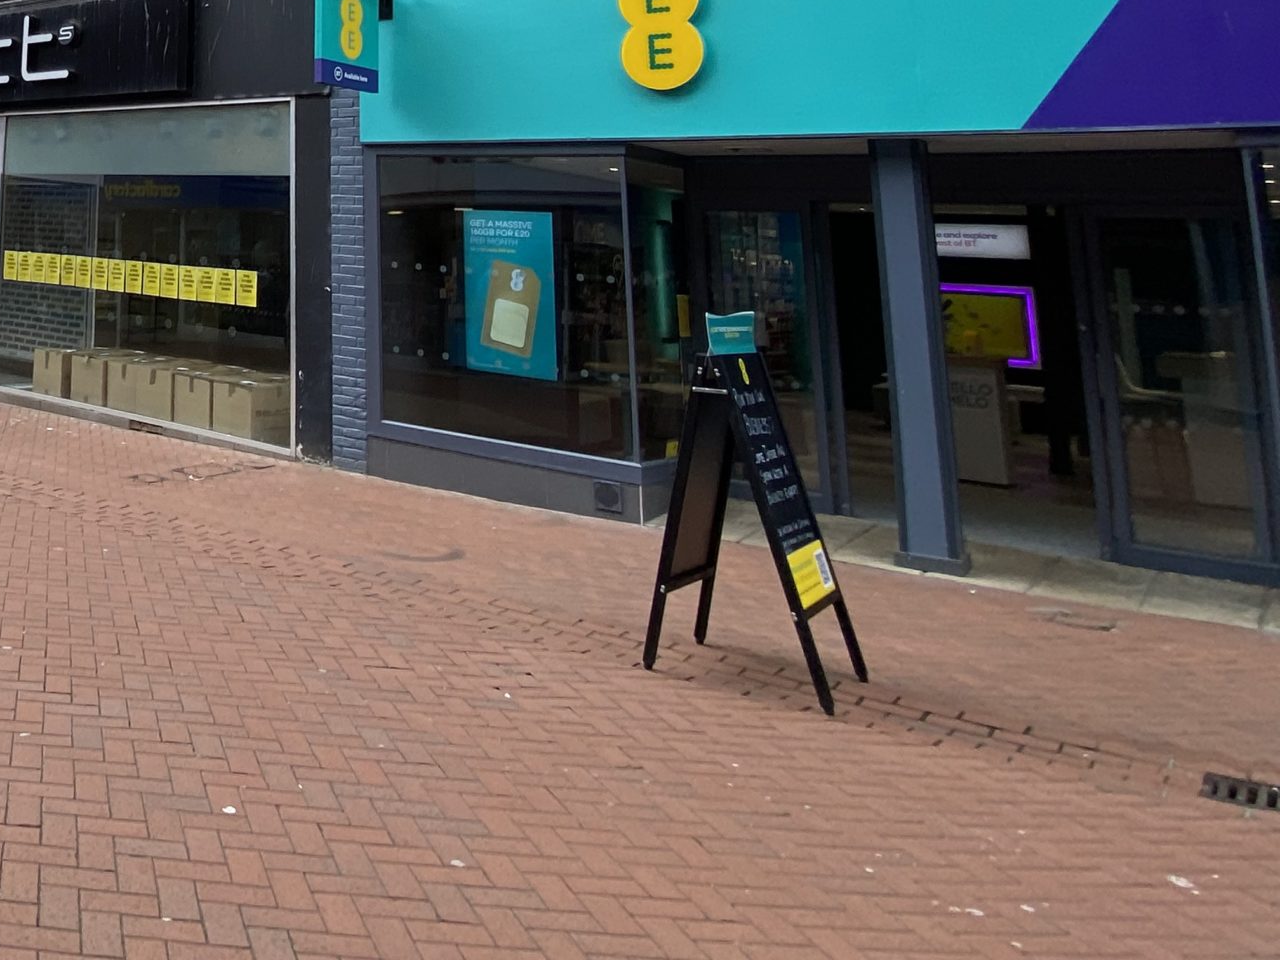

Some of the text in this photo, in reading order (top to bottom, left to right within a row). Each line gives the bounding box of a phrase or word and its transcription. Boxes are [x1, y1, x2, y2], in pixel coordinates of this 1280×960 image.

[470, 220, 485, 228] GET
[495, 221, 532, 230] MASSIVE
[471, 228, 530, 238] 160GB FOR £20
